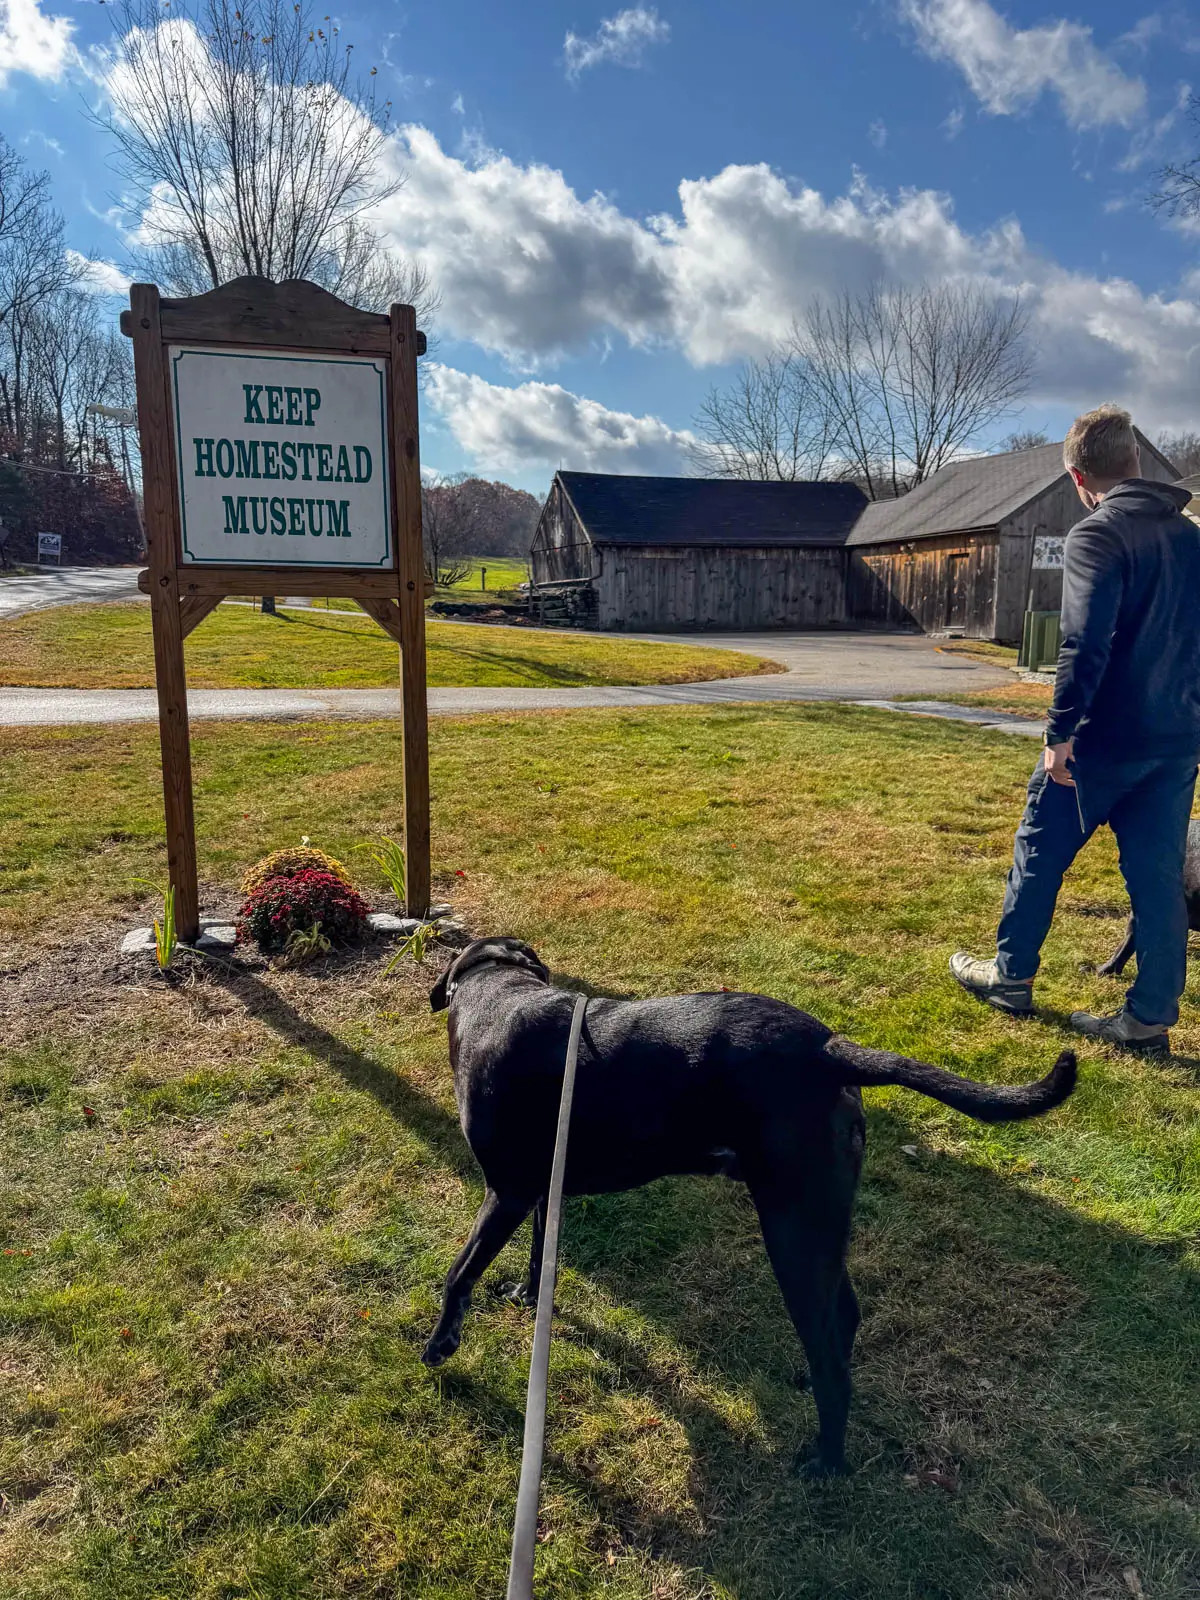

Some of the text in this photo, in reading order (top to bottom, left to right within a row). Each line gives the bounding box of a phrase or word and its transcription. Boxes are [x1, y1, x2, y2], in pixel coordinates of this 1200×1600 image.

[242, 384, 321, 426] KEEP
[193, 437, 373, 483] HOMESTEAD
[222, 496, 352, 537] MUSEUM
